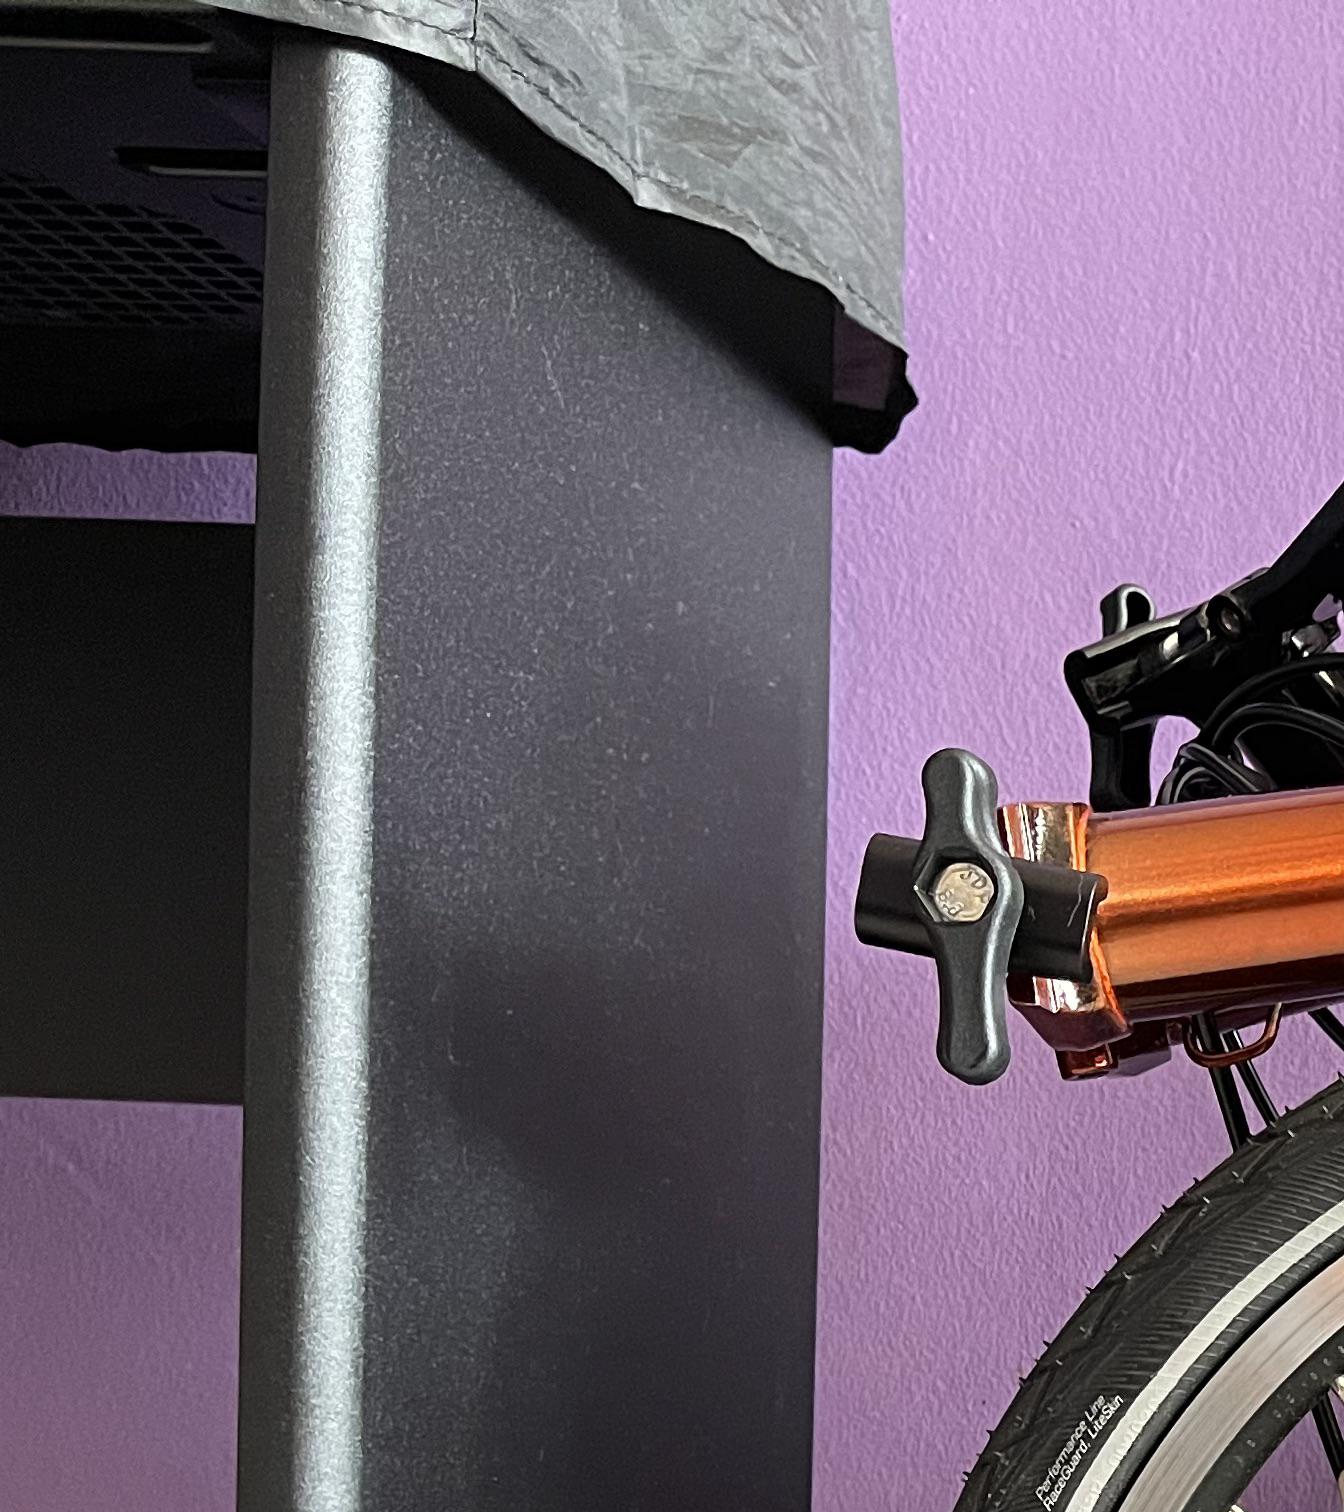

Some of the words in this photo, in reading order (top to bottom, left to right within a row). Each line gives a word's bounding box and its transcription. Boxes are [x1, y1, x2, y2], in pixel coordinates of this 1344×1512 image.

[1035, 1420, 1088, 1501] Performance
[1084, 1395, 1106, 1422] Line
[1086, 1394, 1124, 1439] LiteSkin
